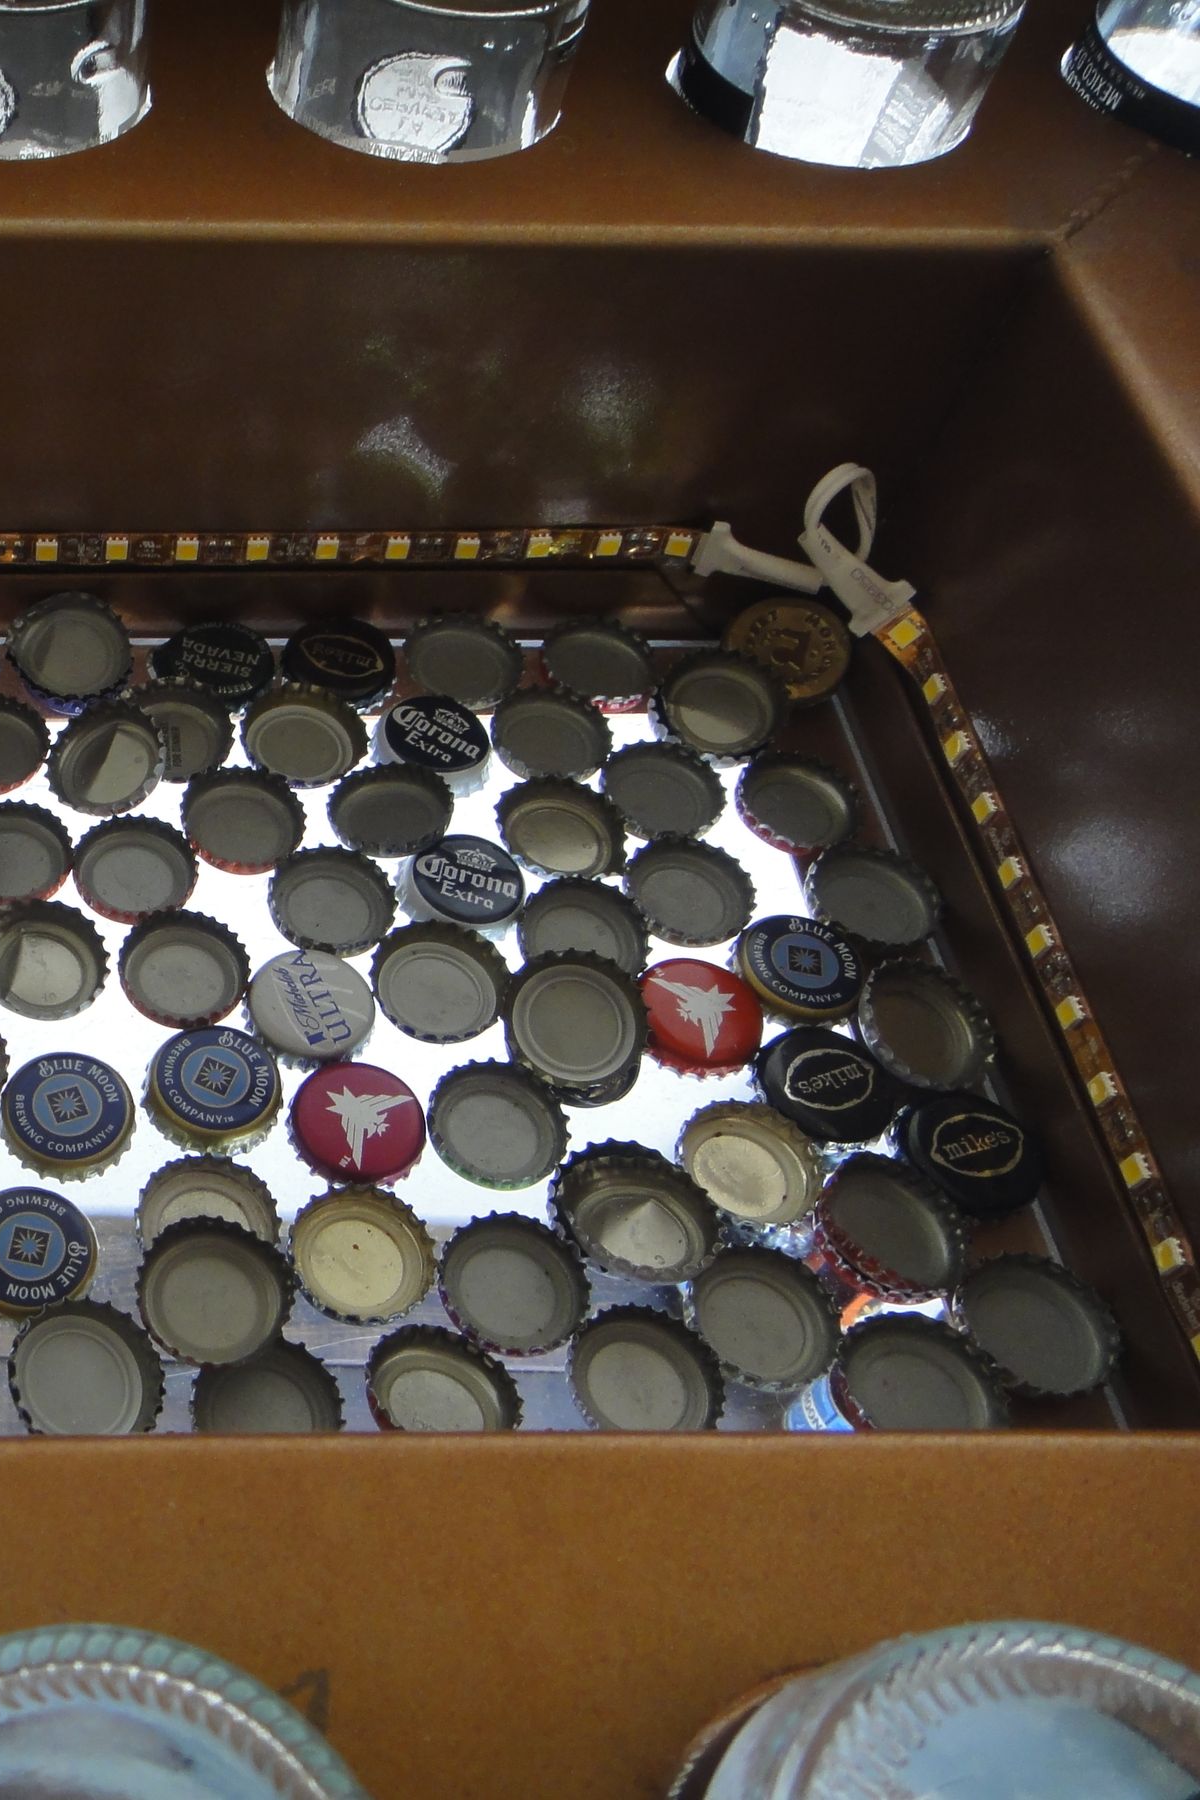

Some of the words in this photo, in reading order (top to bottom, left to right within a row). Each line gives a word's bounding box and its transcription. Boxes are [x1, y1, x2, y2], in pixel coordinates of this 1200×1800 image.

[180, 637, 260, 666] NEVADA
[181, 650, 253, 678] SIERRA
[391, 703, 481, 762] Corona
[403, 728, 454, 765] Extra
[415, 853, 519, 902] Corona
[440, 879, 495, 912] Extra
[753, 933, 777, 985] BREWING
[788, 917, 834, 941] BLUE
[835, 940, 858, 980] MOON
[289, 949, 351, 1045] ULTRA
[38, 1058, 83, 1078] BLUE
[86, 1062, 120, 1105] MOON
[164, 1038, 191, 1086] BREWING
[218, 1030, 261, 1063] BLUE
[253, 1061, 270, 1108] MOON
[796, 1062, 866, 1095] mike's
[14, 1093, 43, 1144] BREWING
[940, 1129, 1011, 1163] mike's
[5, 1197, 68, 1218] BREWING
[56, 1241, 89, 1289] BLUE
[5, 1279, 56, 1299] MOON
